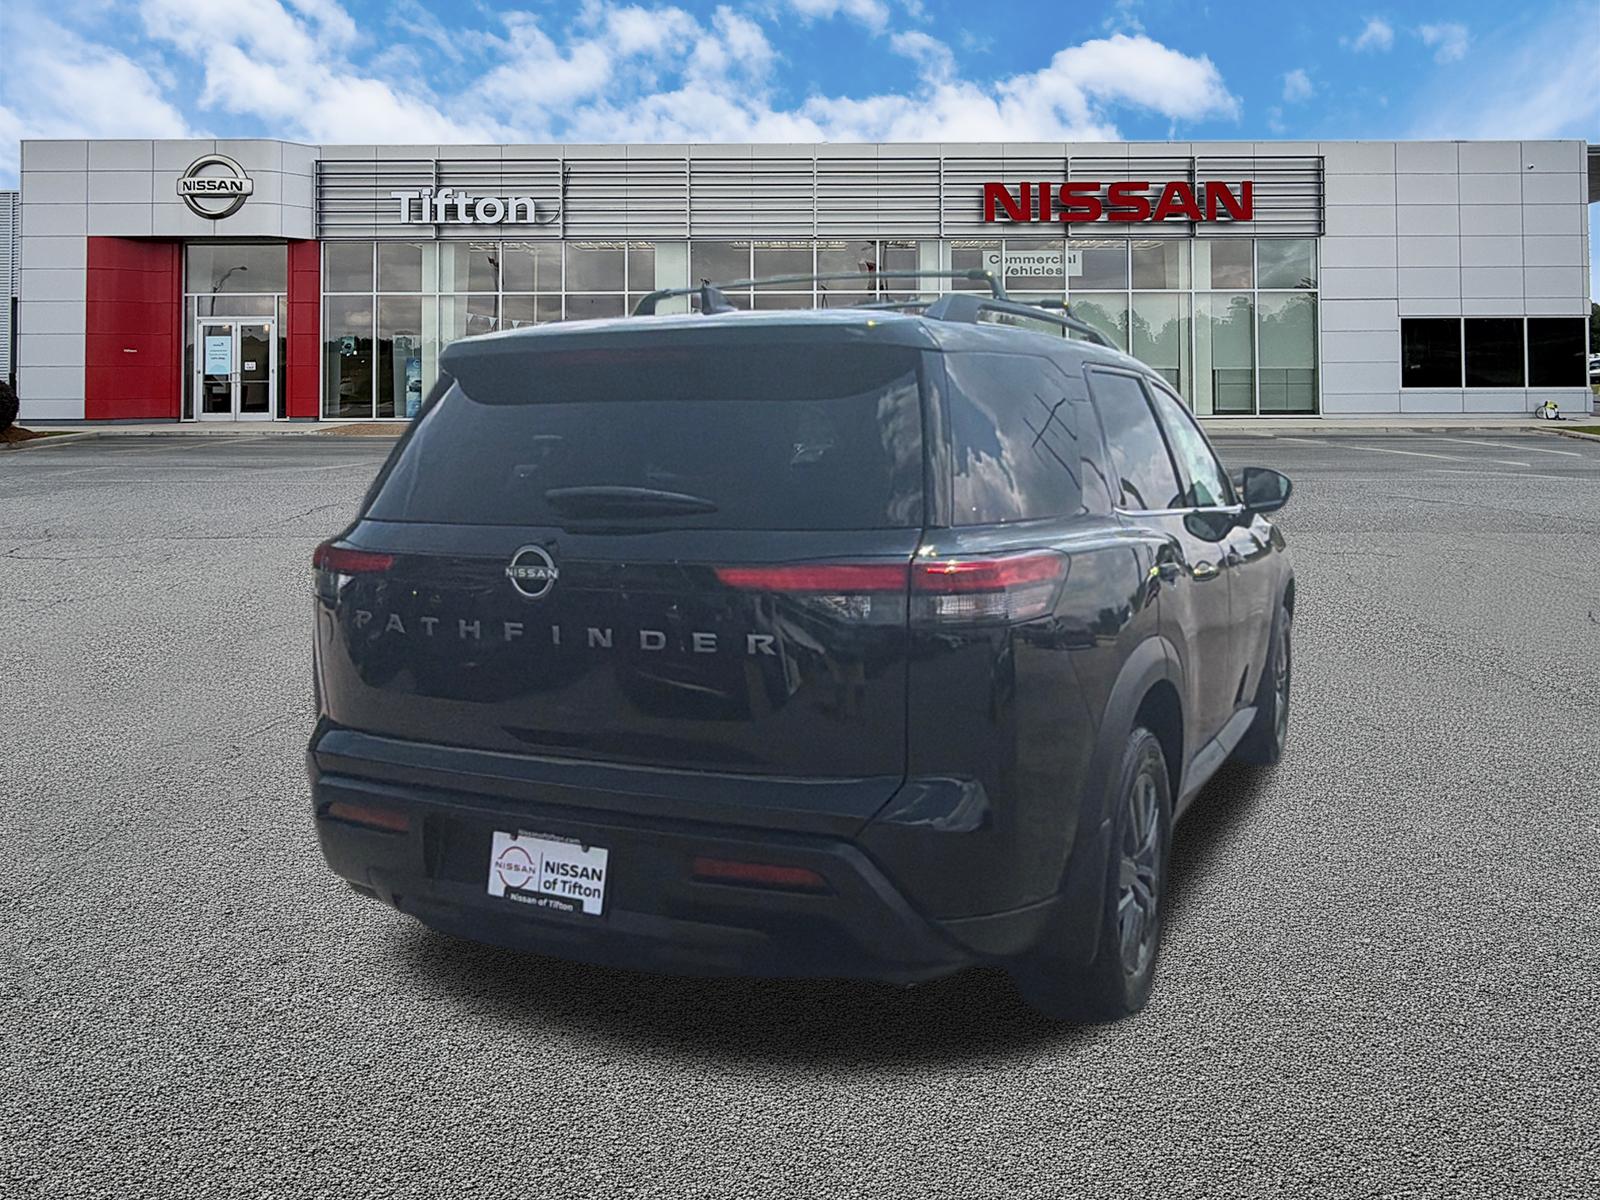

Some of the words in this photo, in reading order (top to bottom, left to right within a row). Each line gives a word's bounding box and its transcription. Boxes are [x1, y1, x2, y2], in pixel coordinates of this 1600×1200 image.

[181, 180, 244, 193] NISSAN
[390, 187, 536, 225] Tifton
[983, 181, 1253, 222] NISSAN
[505, 567, 560, 579] NISSAN
[355, 609, 776, 656] PATHFINDER
[495, 861, 536, 874] NISSAN
[544, 861, 603, 882] NISSAN
[543, 878, 558, 891] of
[560, 880, 602, 899] Tifton
[510, 893, 537, 905] Nissan
[538, 896, 547, 906] of
[548, 899, 574, 911] Tifton
